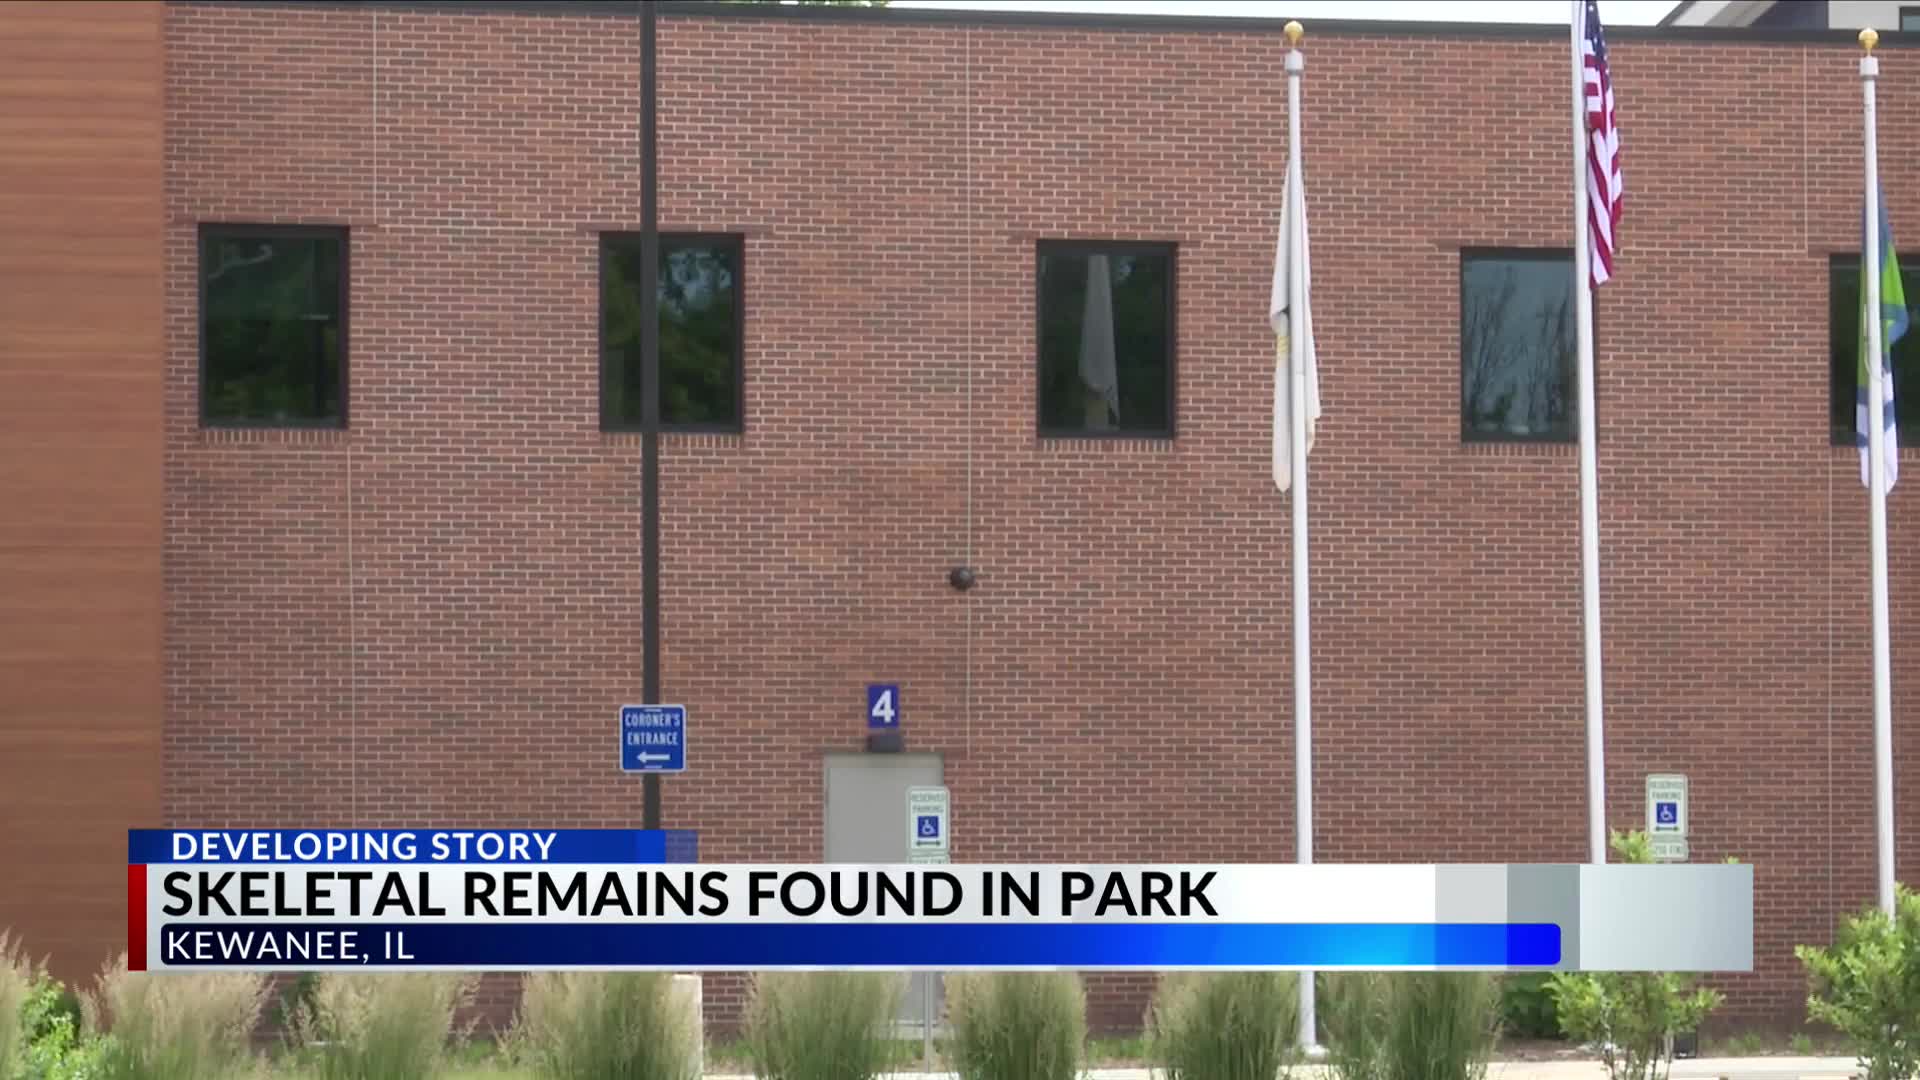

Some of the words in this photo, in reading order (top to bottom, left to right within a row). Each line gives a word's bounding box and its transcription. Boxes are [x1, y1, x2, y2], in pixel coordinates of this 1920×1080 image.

[872, 689, 895, 722] 4
[625, 713, 681, 728] CORONER'S
[627, 732, 678, 745] ENTRANCE
